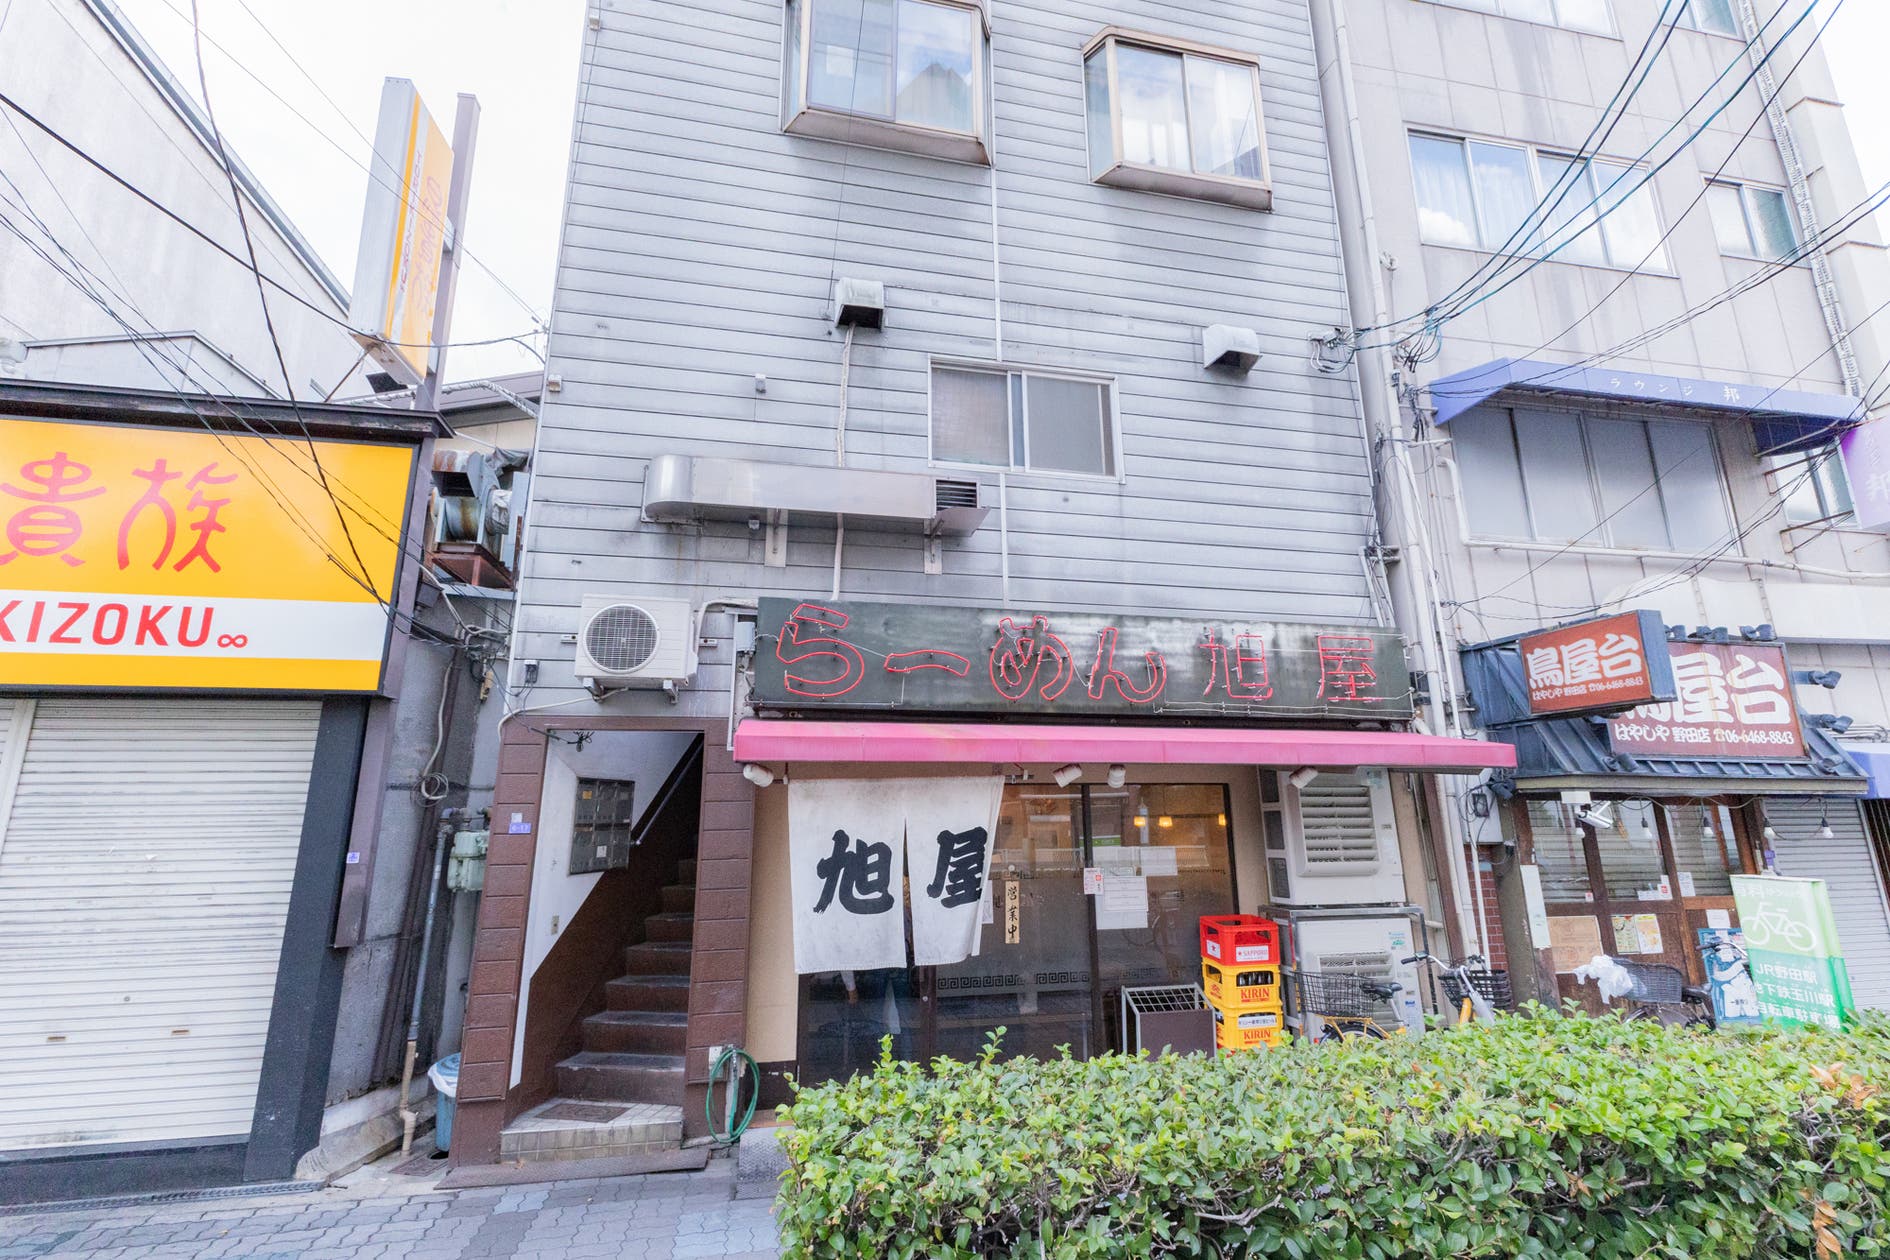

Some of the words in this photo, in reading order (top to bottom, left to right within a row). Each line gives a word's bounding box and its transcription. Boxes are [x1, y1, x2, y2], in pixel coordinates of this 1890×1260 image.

[1611, 377, 1693, 396] ラウンジ
[1723, 385, 1740, 403] 邦
[0, 451, 238, 573] 貴族
[1526, 633, 1644, 689] 鳥屋台
[1622, 652, 1792, 725] 屋台
[1615, 723, 1670, 742] はやしや
[1672, 727, 1711, 743] 野田店
[1725, 730, 1795, 745] 06-6468-8843
[812, 826, 988, 916] 旭屋
[1240, 988, 1270, 999] KIRIN
[1243, 1030, 1271, 1040] KIRIN
